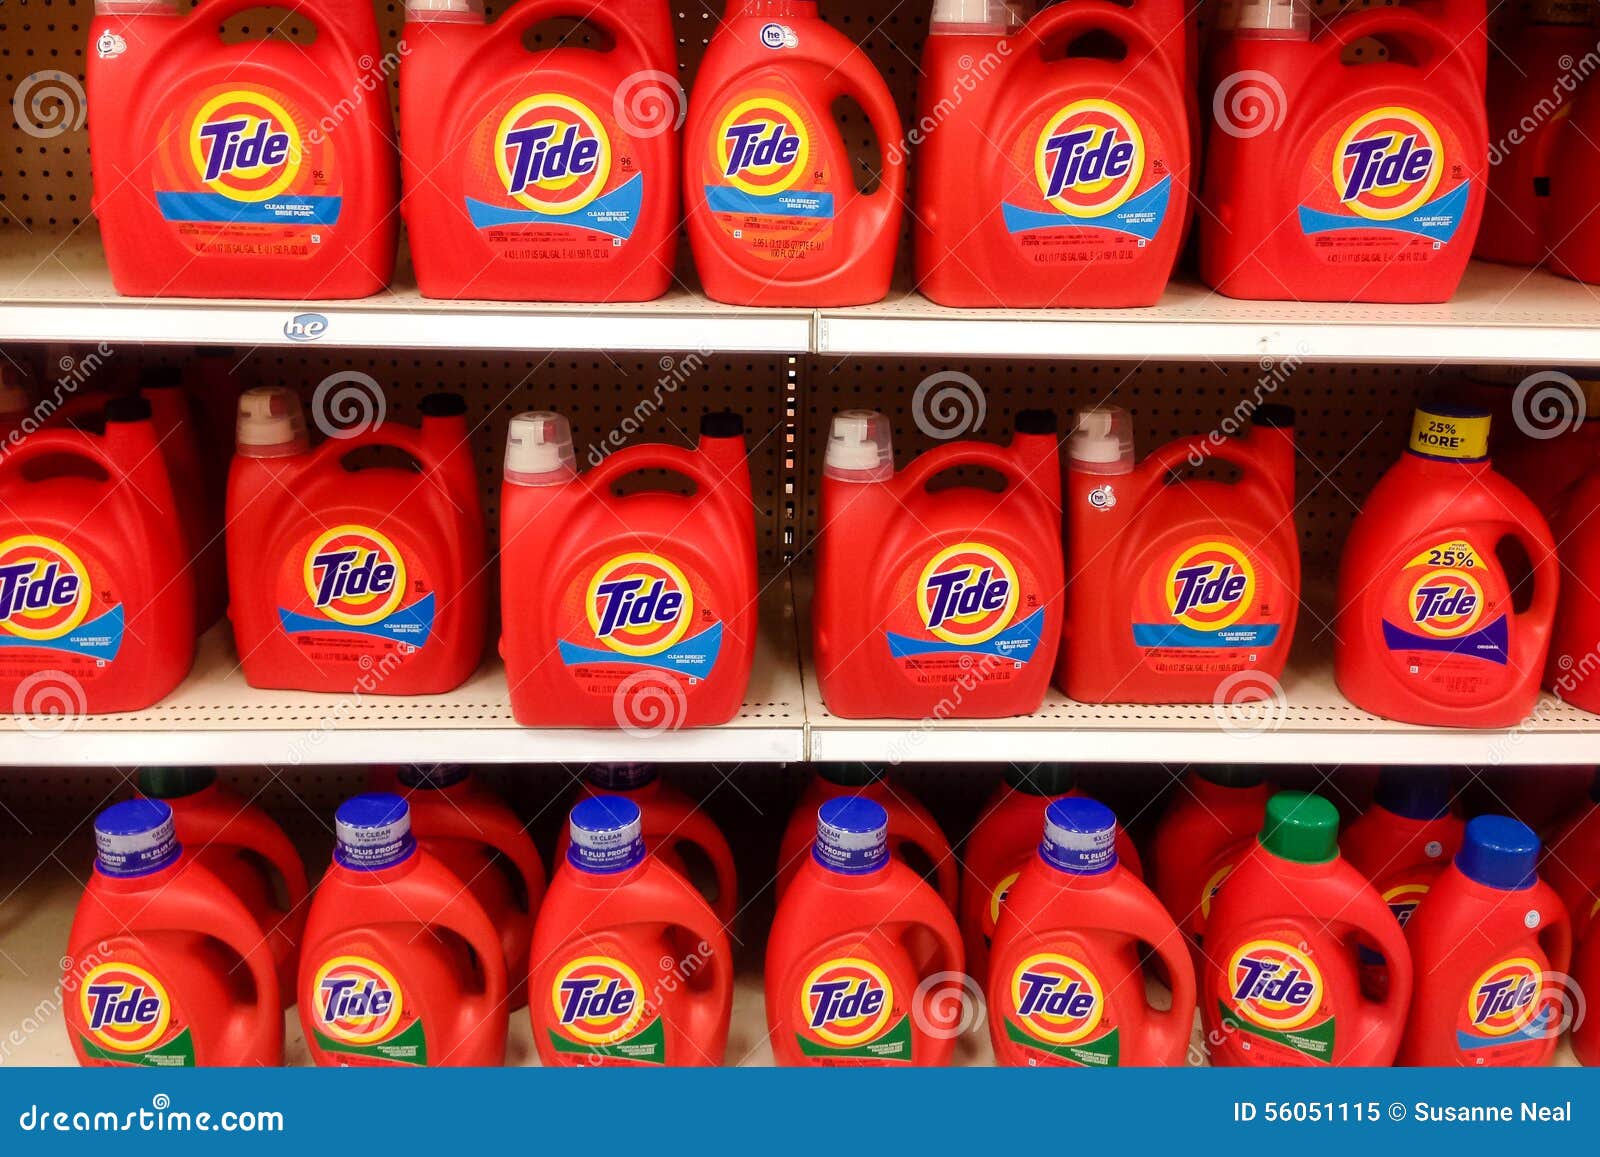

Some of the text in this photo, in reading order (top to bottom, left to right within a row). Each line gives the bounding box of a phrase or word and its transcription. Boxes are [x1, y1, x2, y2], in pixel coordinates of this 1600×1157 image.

[767, 31, 780, 39] he
[200, 118, 290, 183] Tide
[504, 123, 599, 195] Tide
[621, 157, 631, 165] 96
[724, 121, 800, 178] Tide
[1043, 127, 1135, 201] Tide
[1153, 160, 1163, 168] 96
[1340, 134, 1434, 204] Tide
[312, 170, 324, 178] 96
[814, 171, 823, 179] 64
[285, 314, 327, 339] he
[1428, 421, 1456, 435] 25%
[312, 550, 398, 608] Tide
[1428, 550, 1474, 567] 25%
[595, 577, 685, 639] Tide
[925, 567, 1009, 630] Tide
[1171, 563, 1248, 617] Tide
[1413, 586, 1477, 622] Tide
[366, 829, 391, 838] CLEAN
[588, 850, 605, 858] PLUS
[599, 833, 622, 841] CLEAN
[825, 845, 852, 859] PROPRE
[1090, 850, 1107, 859] PLUS
[321, 978, 393, 1023] Tide
[560, 978, 635, 1025] Tide
[809, 978, 884, 1029] Tide
[1016, 971, 1095, 1019] Tide
[1232, 957, 1314, 1006] Tide
[1472, 975, 1537, 1026] Tide
[87, 984, 160, 1030] Tide
